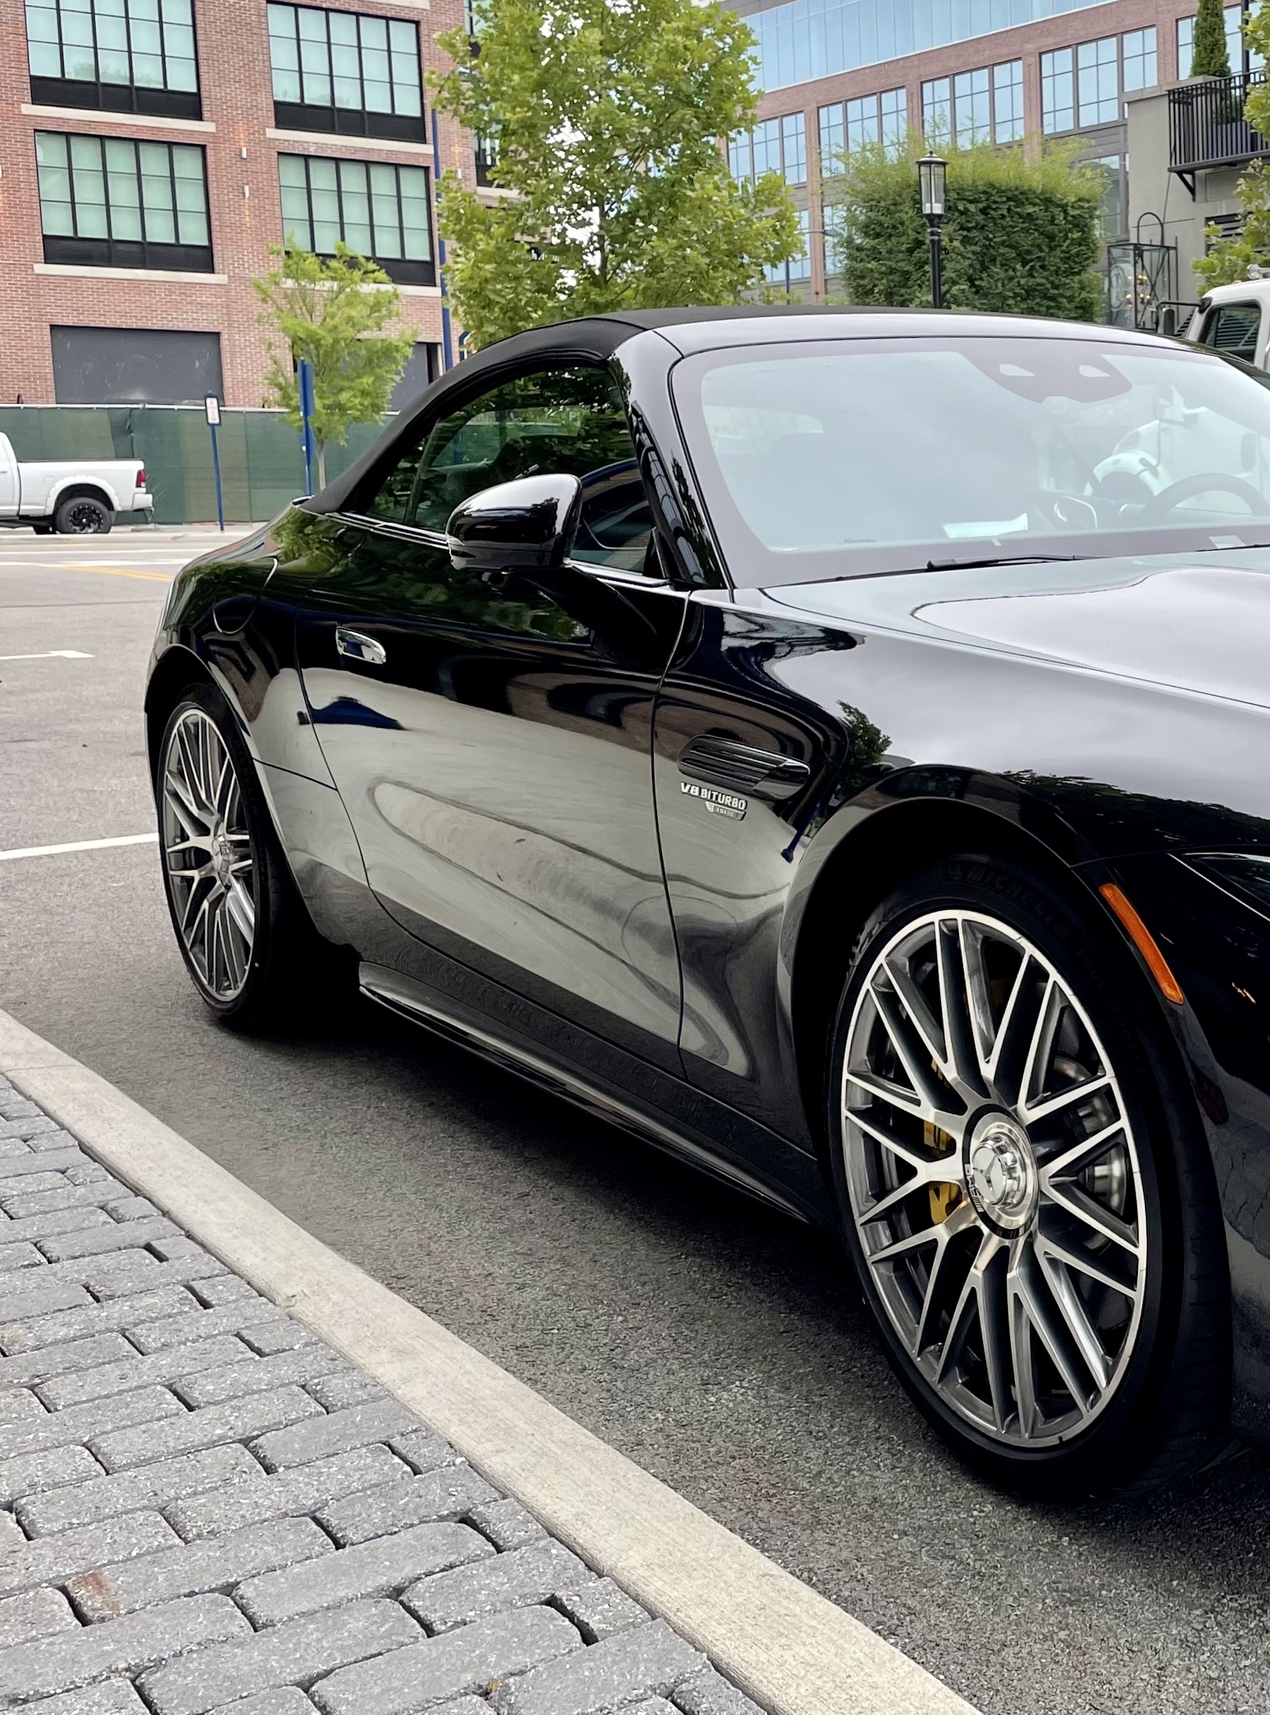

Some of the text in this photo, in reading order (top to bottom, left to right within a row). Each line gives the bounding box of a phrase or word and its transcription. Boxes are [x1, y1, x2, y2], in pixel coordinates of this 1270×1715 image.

[681, 782, 746, 810] V8 BITURBO
[966, 865, 1073, 941] MICHELIN
